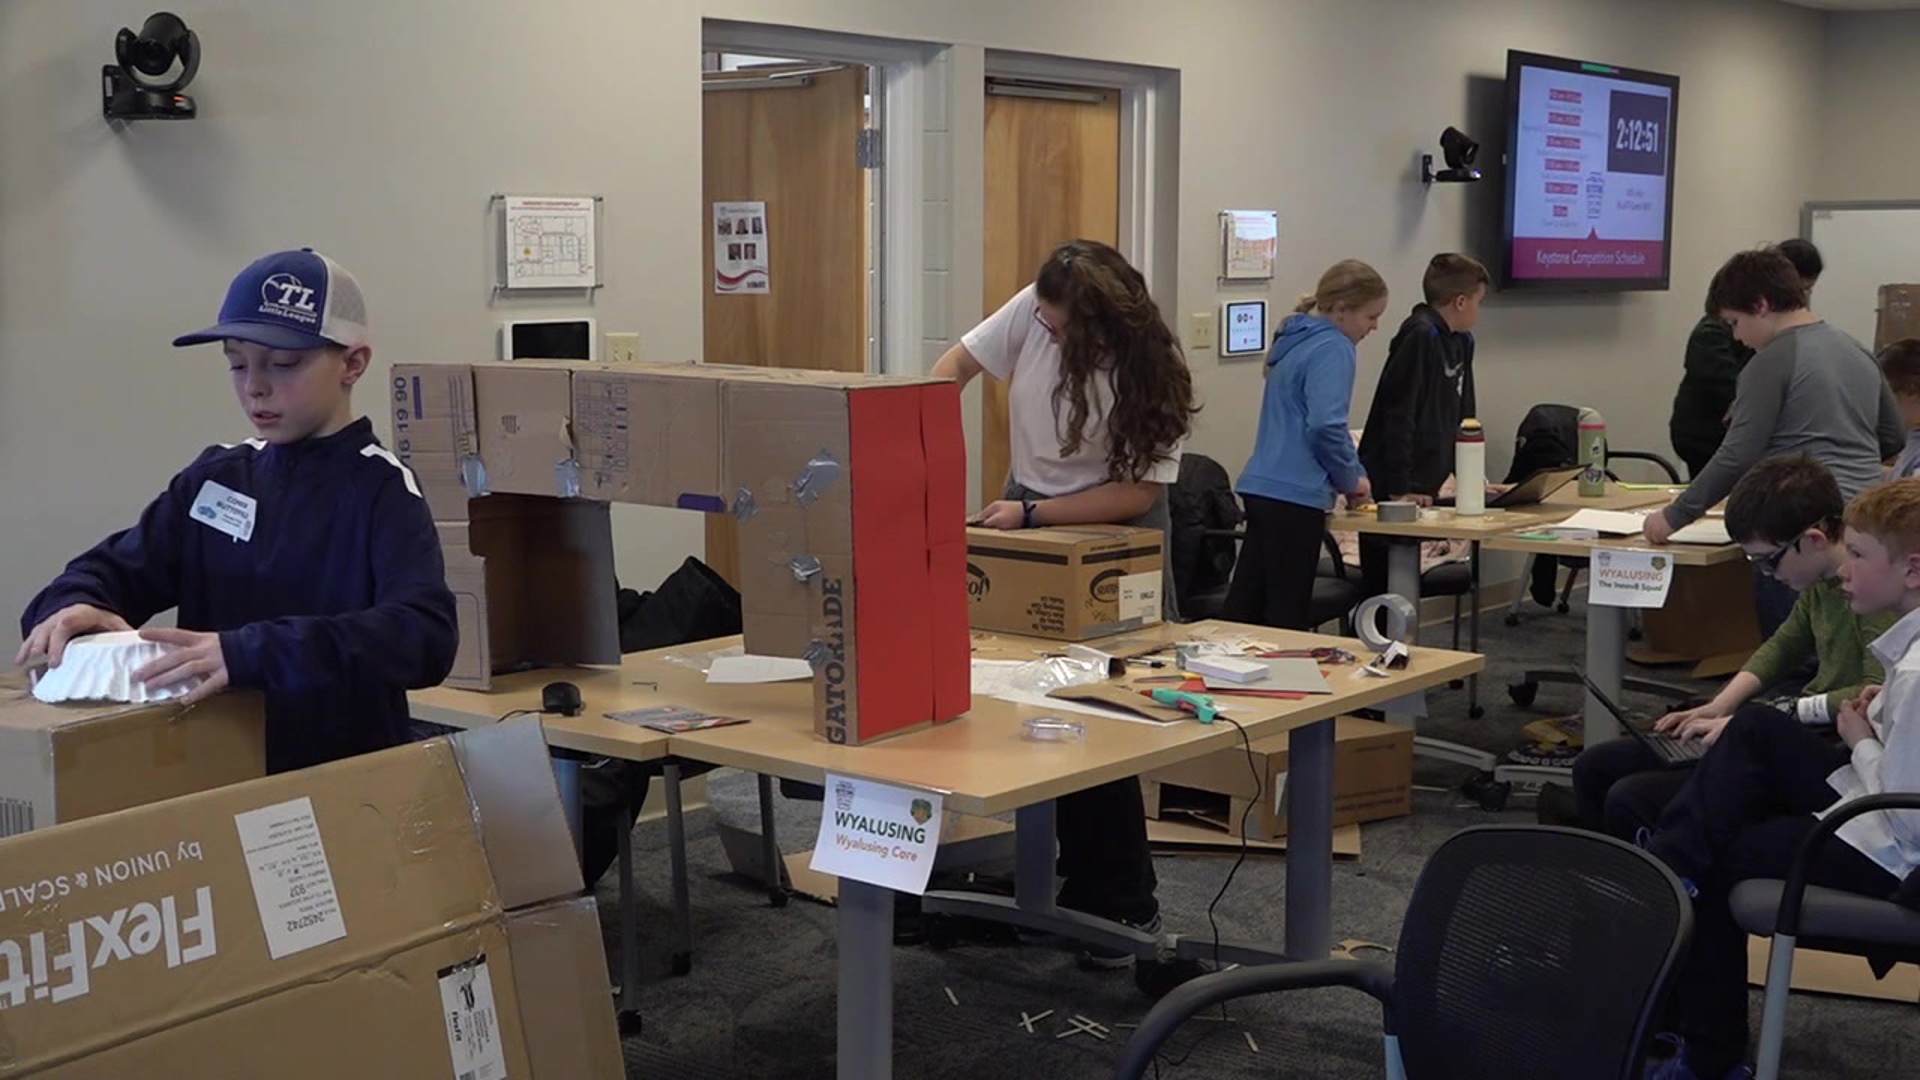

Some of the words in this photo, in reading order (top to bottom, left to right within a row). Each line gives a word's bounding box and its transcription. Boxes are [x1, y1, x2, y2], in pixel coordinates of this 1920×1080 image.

[1615, 117, 1660, 153] 2:12:51
[1535, 249, 1570, 268] Keystone
[1571, 250, 1614, 267] Competition
[1615, 250, 1645, 265] Schedule
[278, 283, 315, 310] TL
[1599, 580, 1612, 588] The
[1600, 568, 1664, 581] WYALUSING
[835, 811, 925, 844] WYALUSING
[177, 841, 203, 861] by
[836, 833, 889, 858] Wyalusing
[75, 872, 88, 888] &
[94, 850, 171, 886] UNION
[0, 886, 217, 1007] FlexFit
